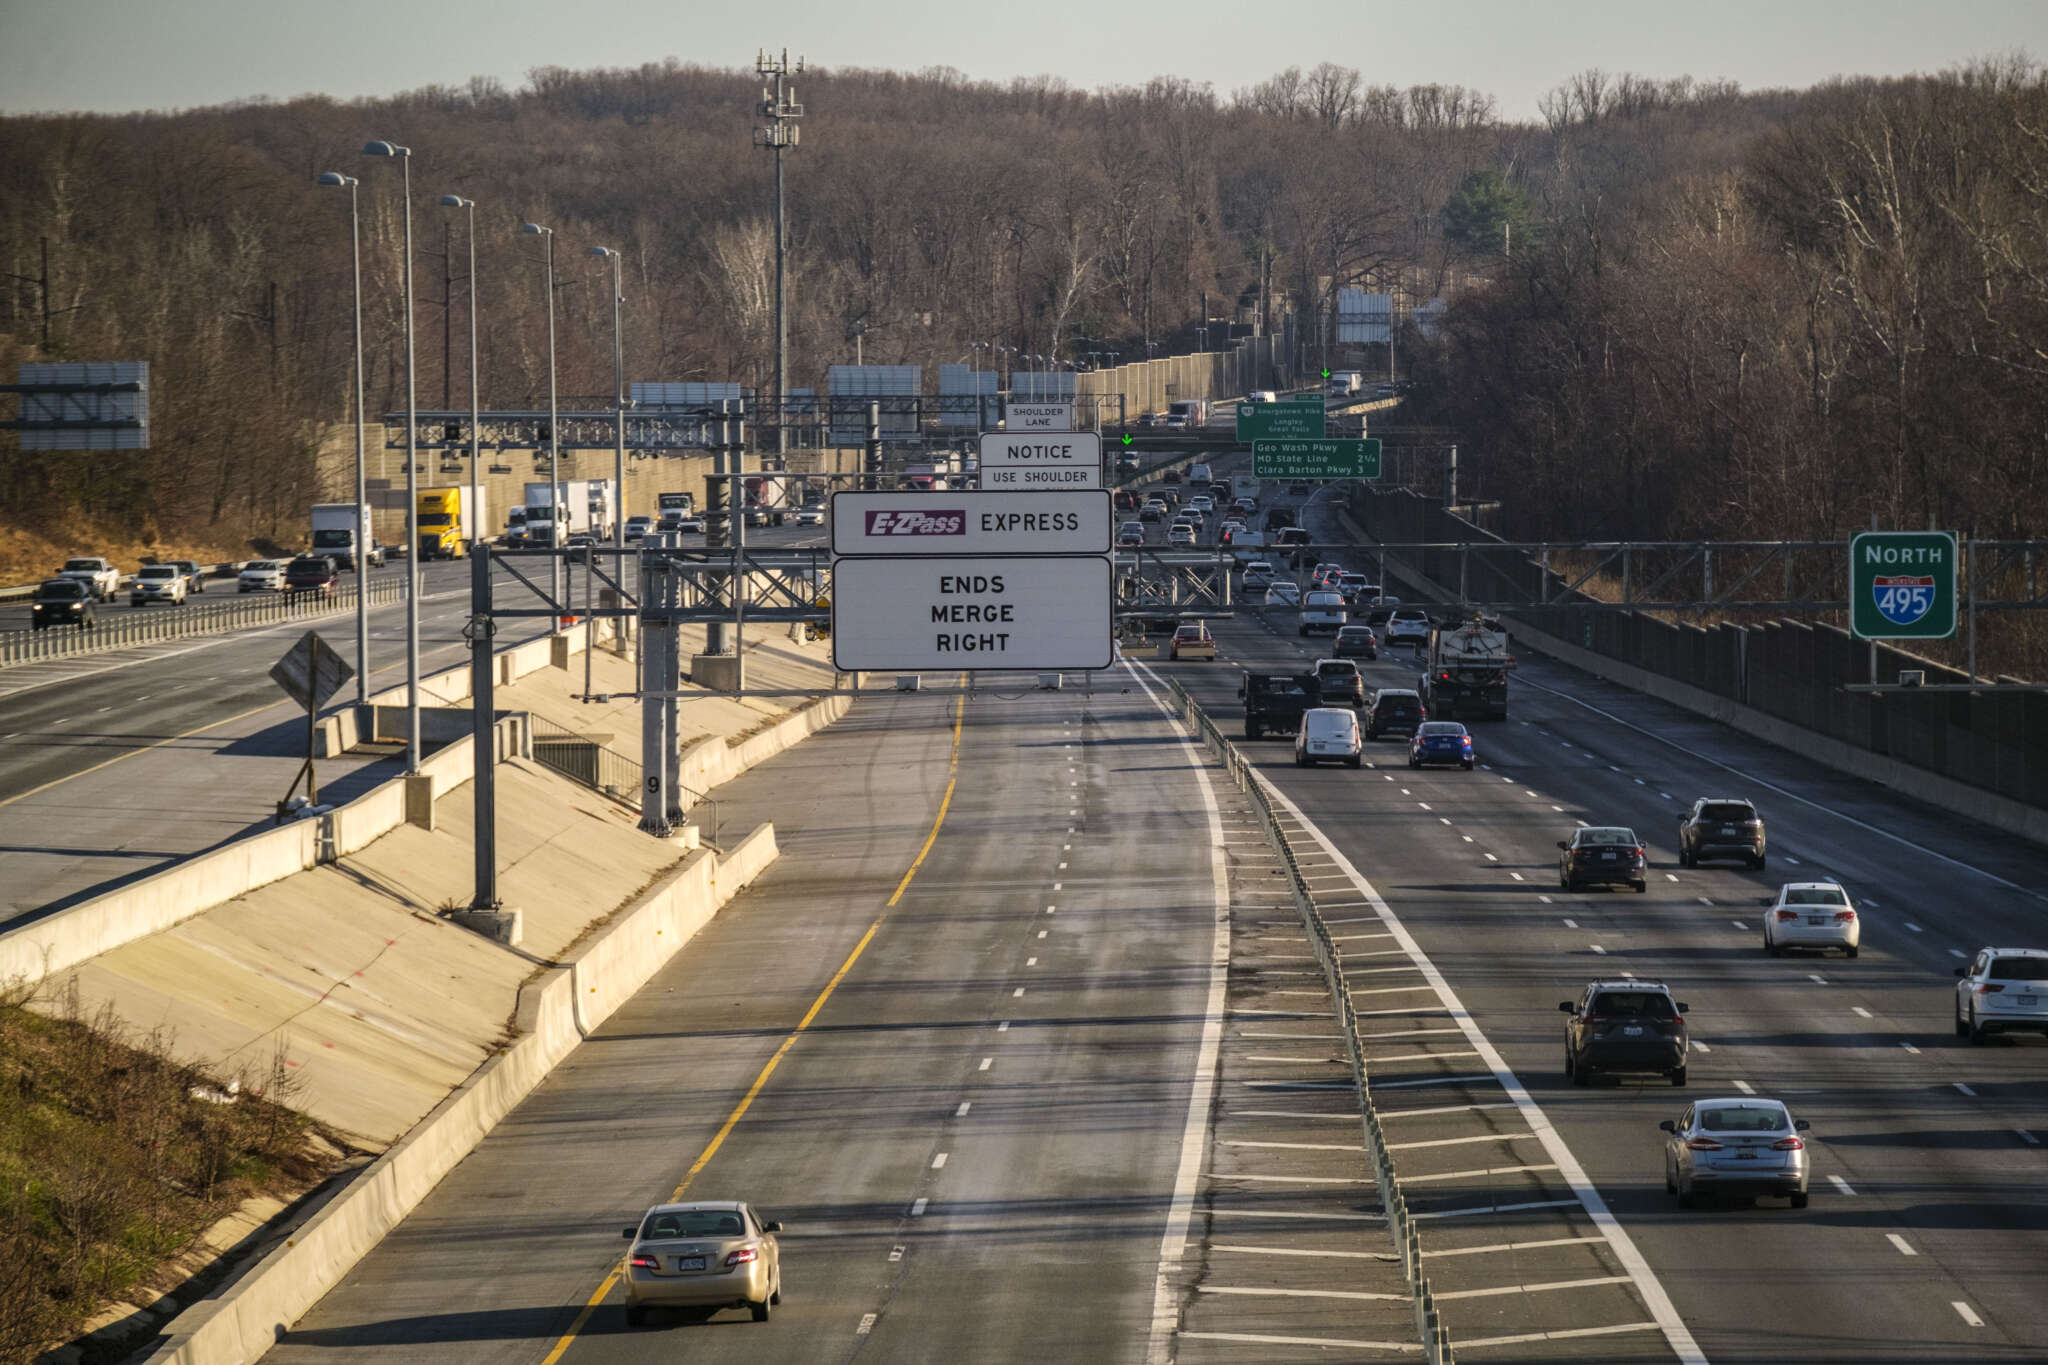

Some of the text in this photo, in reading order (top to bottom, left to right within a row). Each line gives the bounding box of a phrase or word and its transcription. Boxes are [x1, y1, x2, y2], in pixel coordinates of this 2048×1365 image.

[1013, 408, 1063, 416] SHOULDER
[1025, 418, 1051, 426] LANE
[1007, 445, 1072, 459] NOTICE
[1257, 443, 1364, 454] Geo Wash Pkwy 2
[1276, 455, 1302, 463] State
[1307, 455, 1329, 463] Line
[993, 471, 1087, 482] USE SHOULDER
[1257, 465, 1364, 475] Clara Barton Pkwy 3
[870, 512, 1079, 535] E-ZPass EXPRESS
[1865, 545, 1942, 564] NORTH
[940, 576, 1005, 593] ENDS
[1879, 588, 1928, 615] 495
[931, 605, 1014, 623] MERGE
[937, 634, 1010, 652] RIGHT
[648, 776, 660, 794] 9
